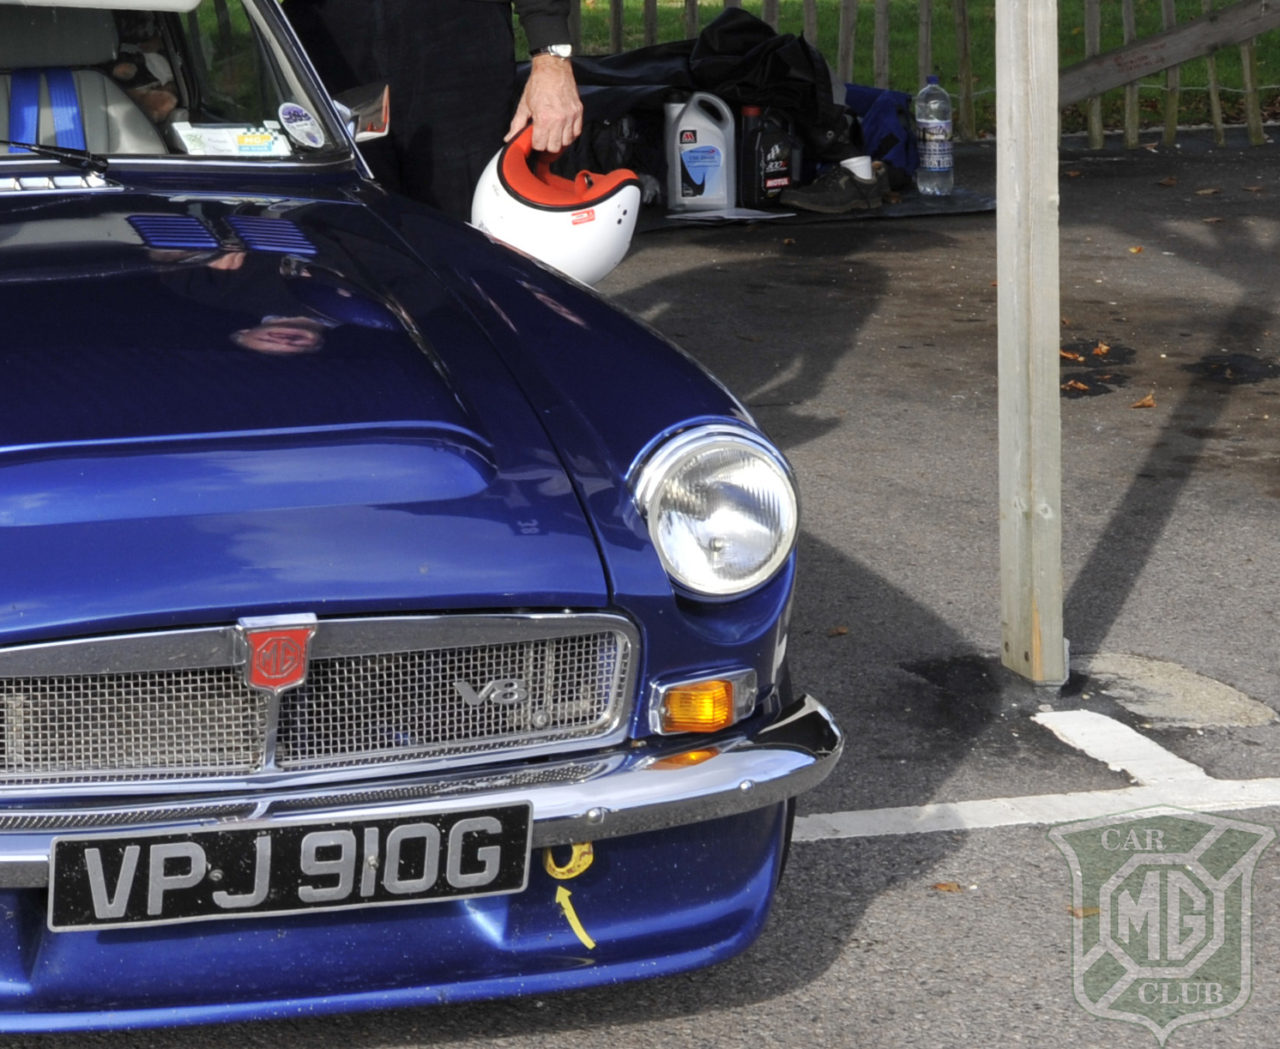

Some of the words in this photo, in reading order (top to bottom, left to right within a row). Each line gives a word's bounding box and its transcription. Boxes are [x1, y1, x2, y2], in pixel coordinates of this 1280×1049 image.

[260, 637, 299, 674] MG
[453, 678, 528, 707] V8
[84, 835, 272, 920] VPJ
[297, 816, 503, 903] 910G
